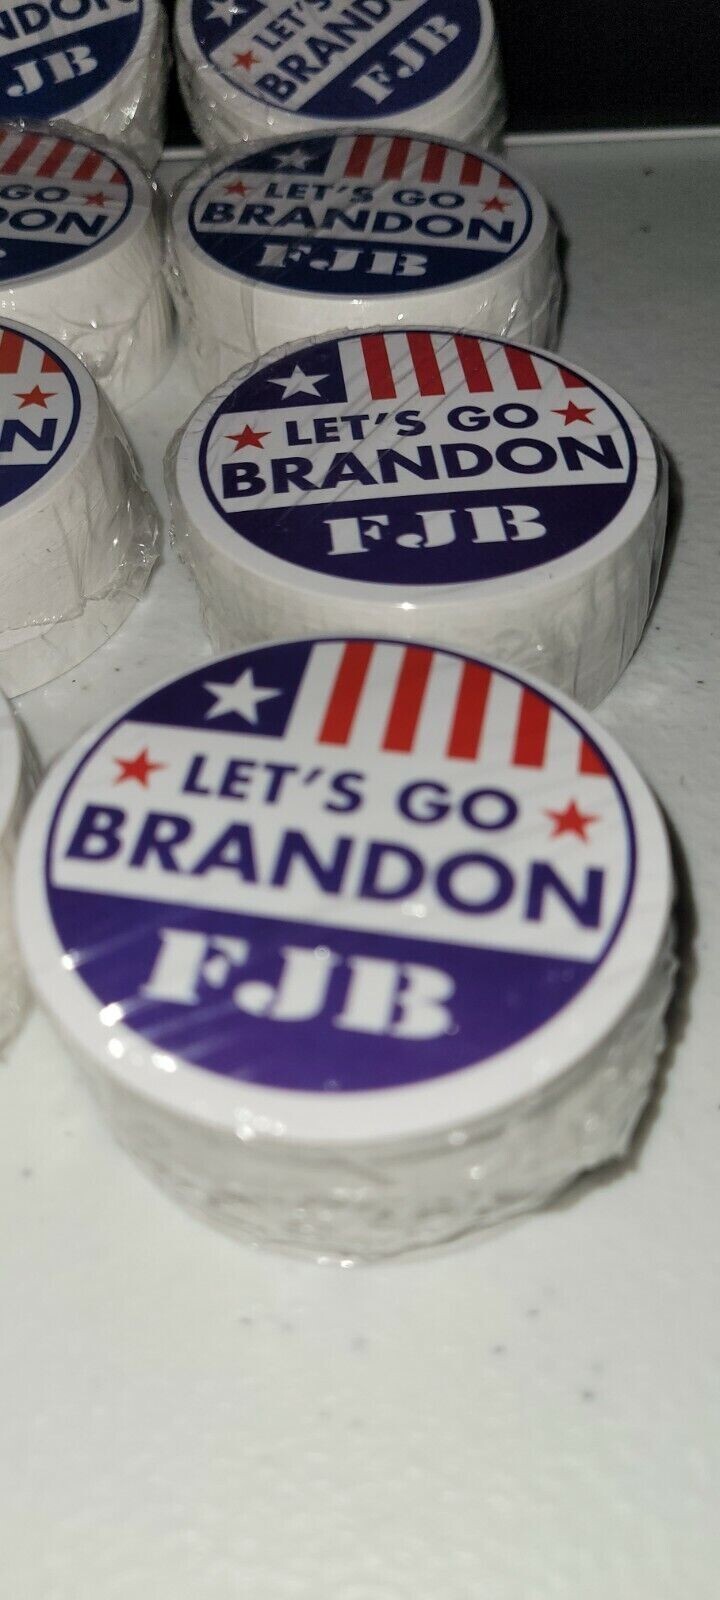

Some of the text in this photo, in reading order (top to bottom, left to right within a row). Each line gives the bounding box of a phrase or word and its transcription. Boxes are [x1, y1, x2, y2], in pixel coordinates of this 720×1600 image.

[0, 0, 134, 40] DO
[6, 45, 98, 97] JB
[352, 15, 461, 105] FJB
[0, 184, 71, 203] GO
[265, 182, 466, 209] LET'S GO
[0, 207, 109, 238] ON
[200, 202, 515, 244] BRANDON
[257, 244, 428, 277] FJB
[285, 402, 539, 446] LET'S GO
[221, 434, 624, 499] BRANDON
[323, 504, 548, 556] FJB
[182, 754, 519, 832] LET'S GO
[64, 803, 607, 931] BRANDON
[140, 928, 456, 1041] FJB
